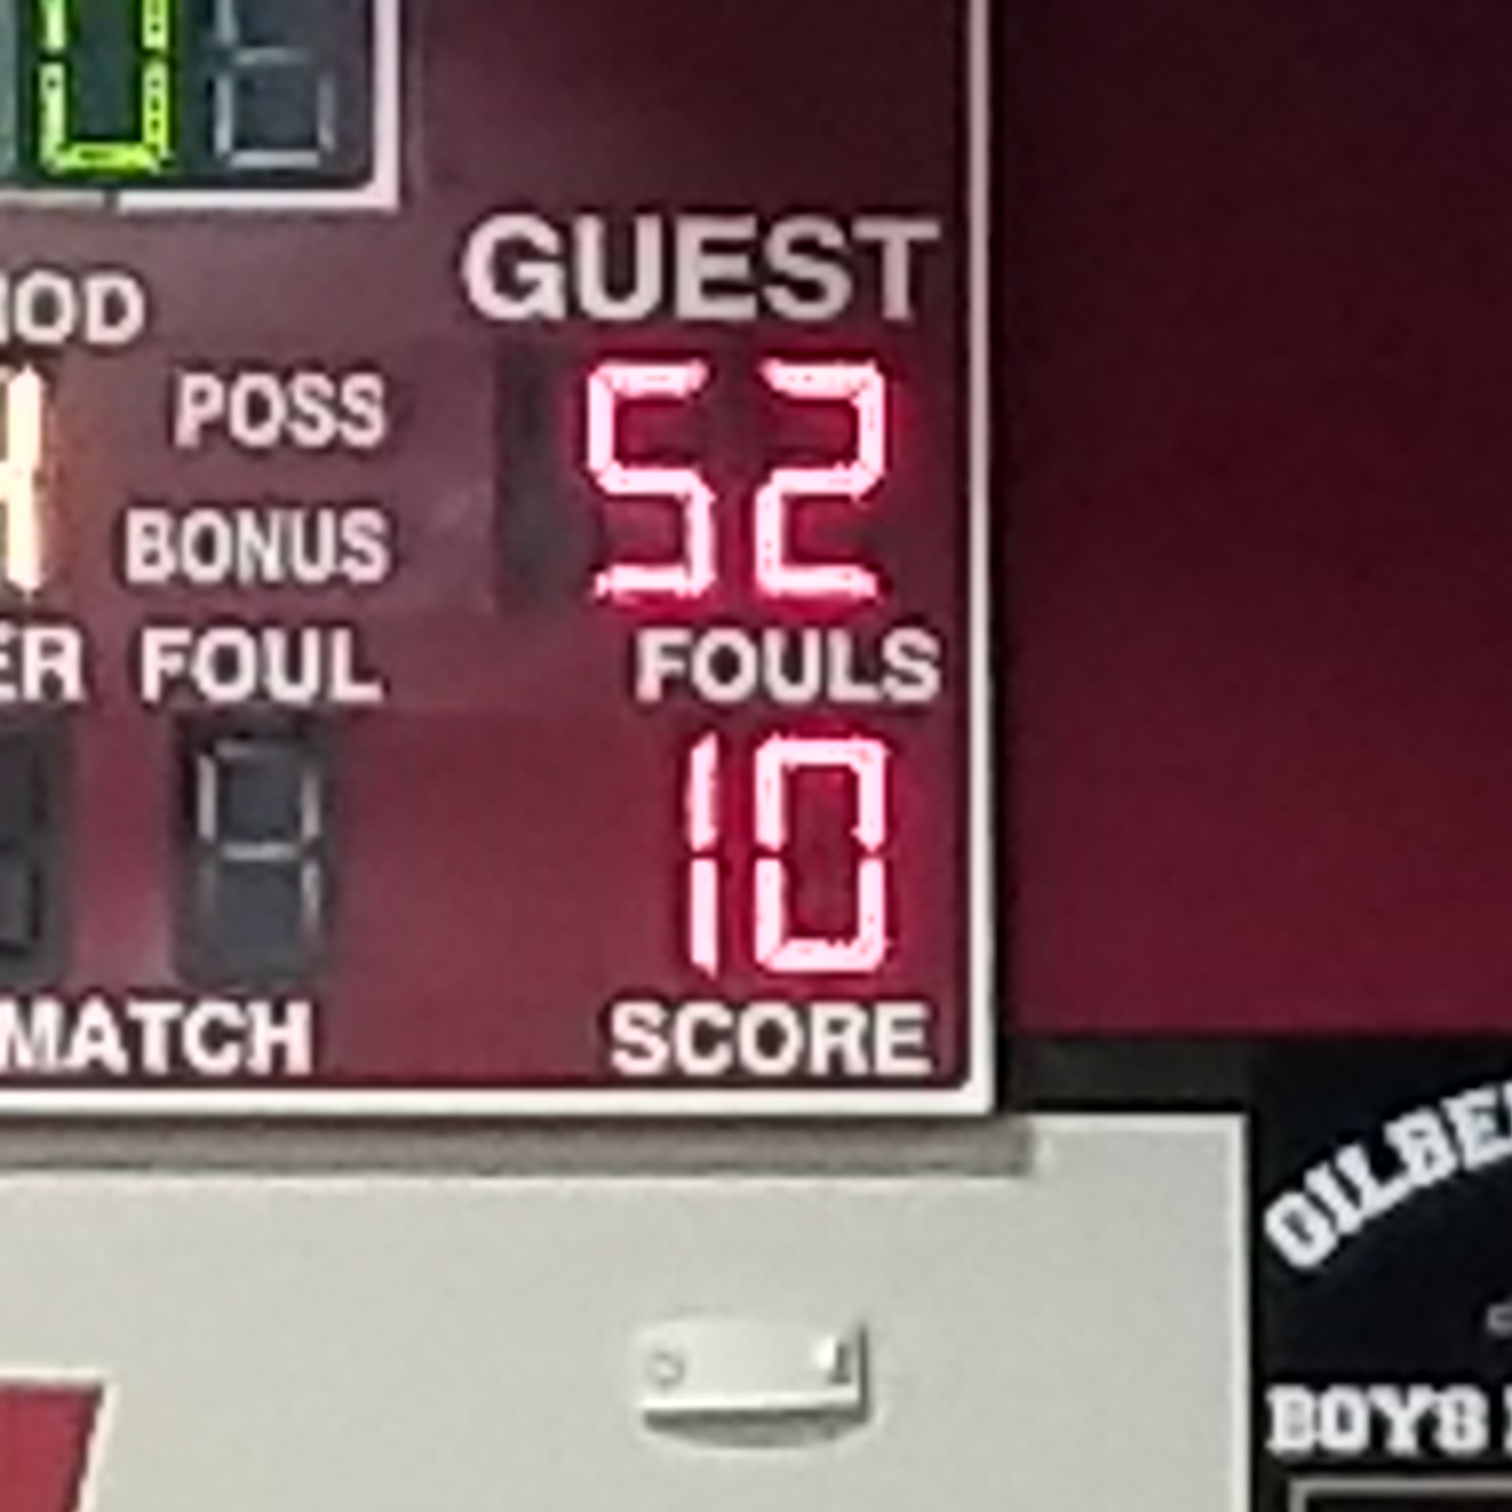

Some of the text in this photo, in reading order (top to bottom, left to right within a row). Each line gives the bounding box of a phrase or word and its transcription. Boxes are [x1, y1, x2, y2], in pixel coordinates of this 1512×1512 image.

[462, 213, 941, 322] GUEST
[174, 372, 388, 448] POSS
[587, 359, 886, 598] 52
[125, 507, 390, 584] BONUS
[141, 626, 385, 704] FOUL
[635, 627, 941, 703] FOULS
[686, 731, 890, 978] 10
[609, 1001, 933, 1078] SCORE
[1265, 1383, 1489, 1457] BOYS
